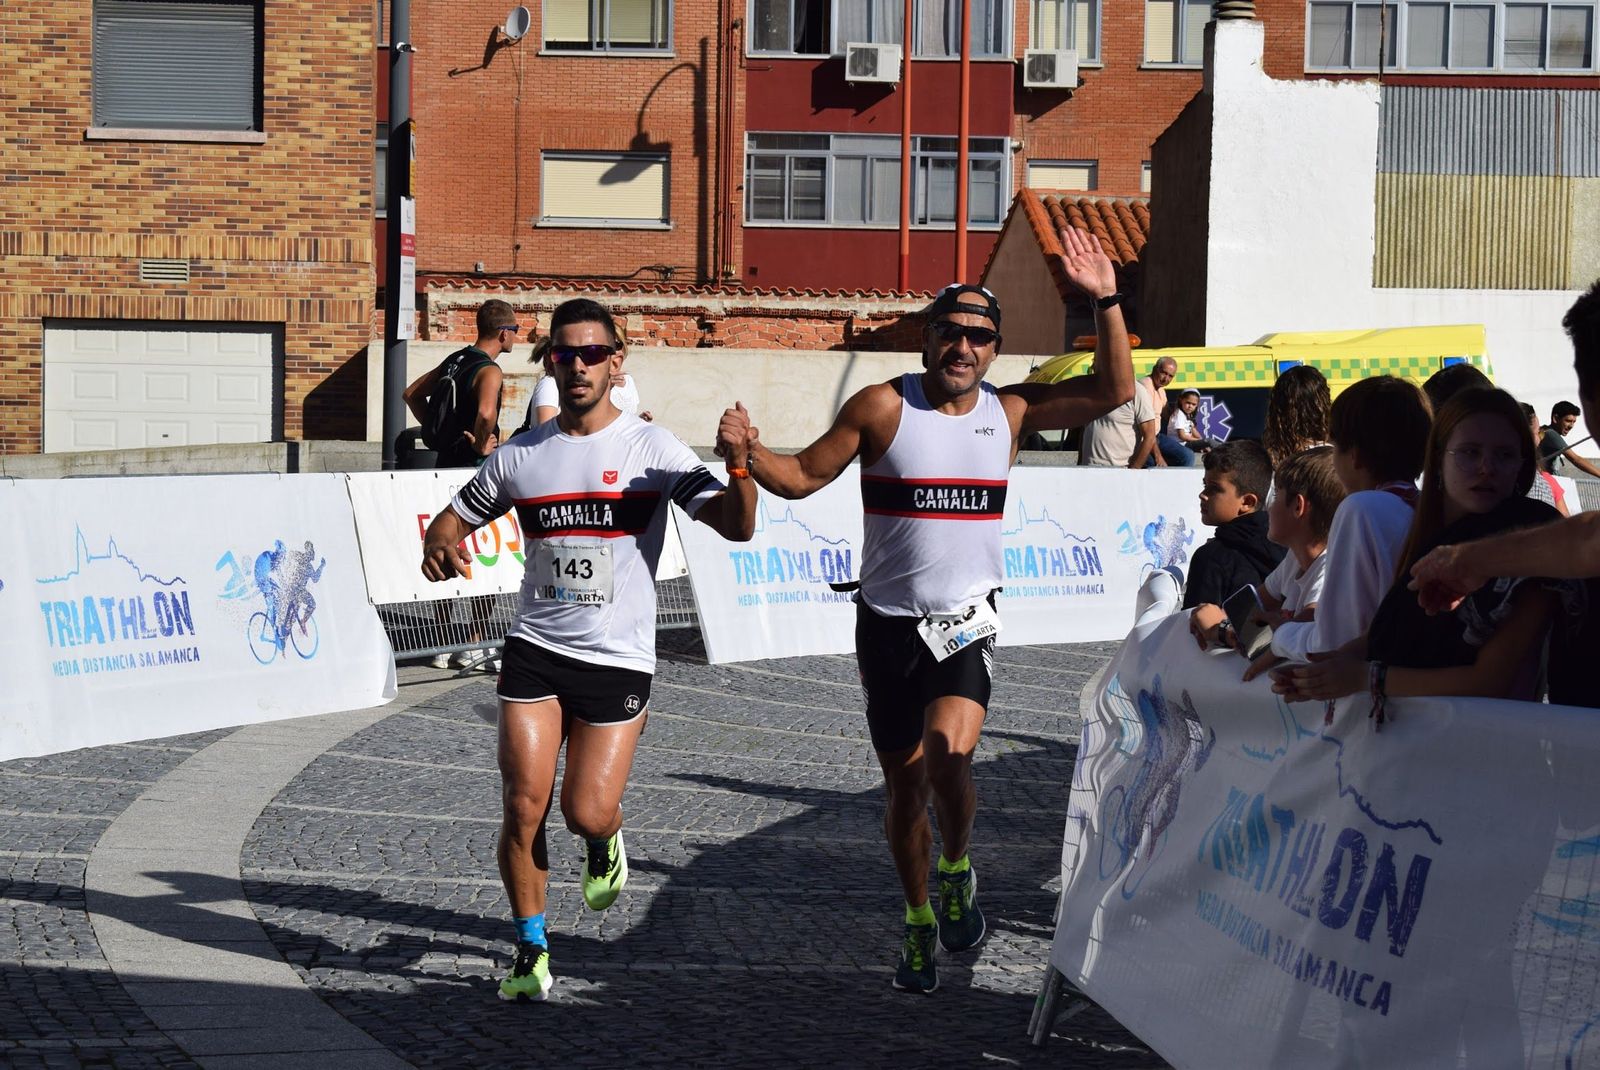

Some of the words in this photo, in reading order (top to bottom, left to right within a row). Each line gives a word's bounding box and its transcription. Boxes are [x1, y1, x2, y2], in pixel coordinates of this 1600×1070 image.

[914, 488, 988, 510] CANALLA
[539, 504, 613, 528] CANALLA
[552, 557, 593, 579] 143
[729, 547, 852, 585] TRIATHLON
[1003, 545, 1103, 578] RIATHLON
[766, 590, 810, 604] DISTANCIA
[1023, 585, 1060, 597] DISTANCIA
[1062, 584, 1104, 596] SALAMANCA
[40, 590, 195, 648] TRIATHLON
[53, 659, 80, 677] MEDIA
[84, 653, 136, 673] DISTANCIA
[139, 647, 200, 668] SALAMANCA
[1273, 935, 1392, 1016] SALAMANCA
